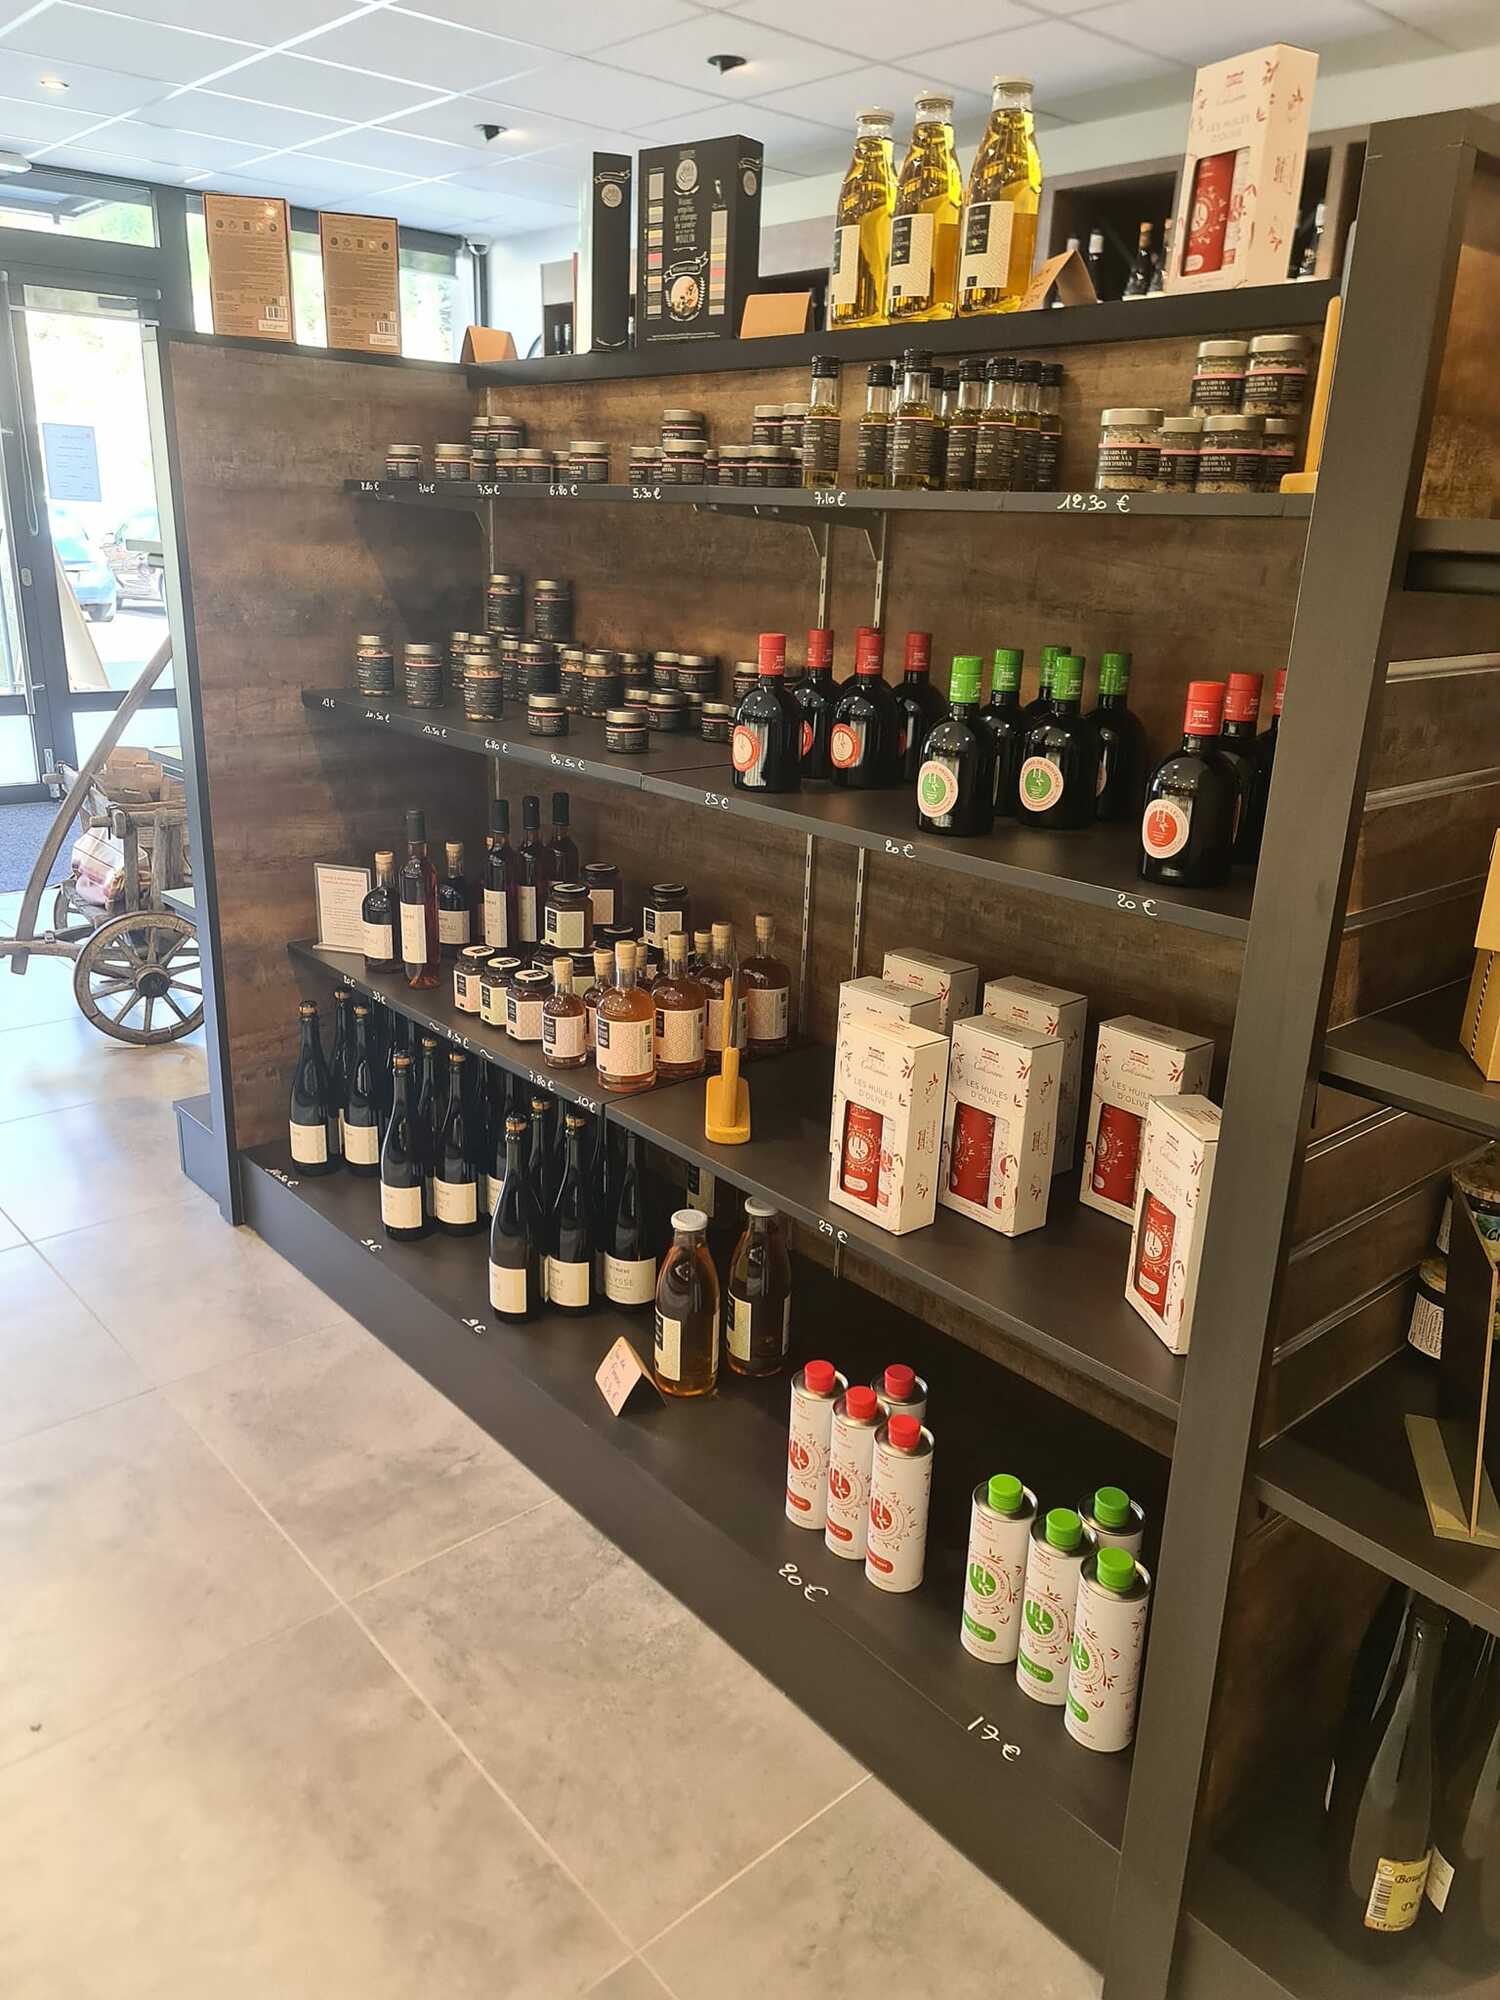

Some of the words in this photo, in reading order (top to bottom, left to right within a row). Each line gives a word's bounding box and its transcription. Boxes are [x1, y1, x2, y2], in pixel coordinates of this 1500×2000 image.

[570, 484, 579, 496] €
[632, 487, 652, 499] 5,30
[653, 487, 662, 500] €
[814, 490, 836, 505] 7,10
[837, 491, 848, 507] €
[1116, 495, 1131, 513] €
[577, 759, 585, 771] €
[721, 797, 729, 809] €
[902, 843, 916, 858] €
[1117, 893, 1136, 909] 20
[1141, 900, 1157, 916] €
[547, 1080, 555, 1092] €
[966, 1079, 980, 1090] LES
[980, 1084, 1009, 1101] HUILES
[1111, 1079, 1127, 1091] LES
[589, 1102, 597, 1114] €
[818, 1219, 834, 1237] 27
[837, 1230, 849, 1244] €
[803, 1582, 830, 1603] €
[966, 1715, 1001, 1742] 17
[1001, 1742, 1022, 1762] €
